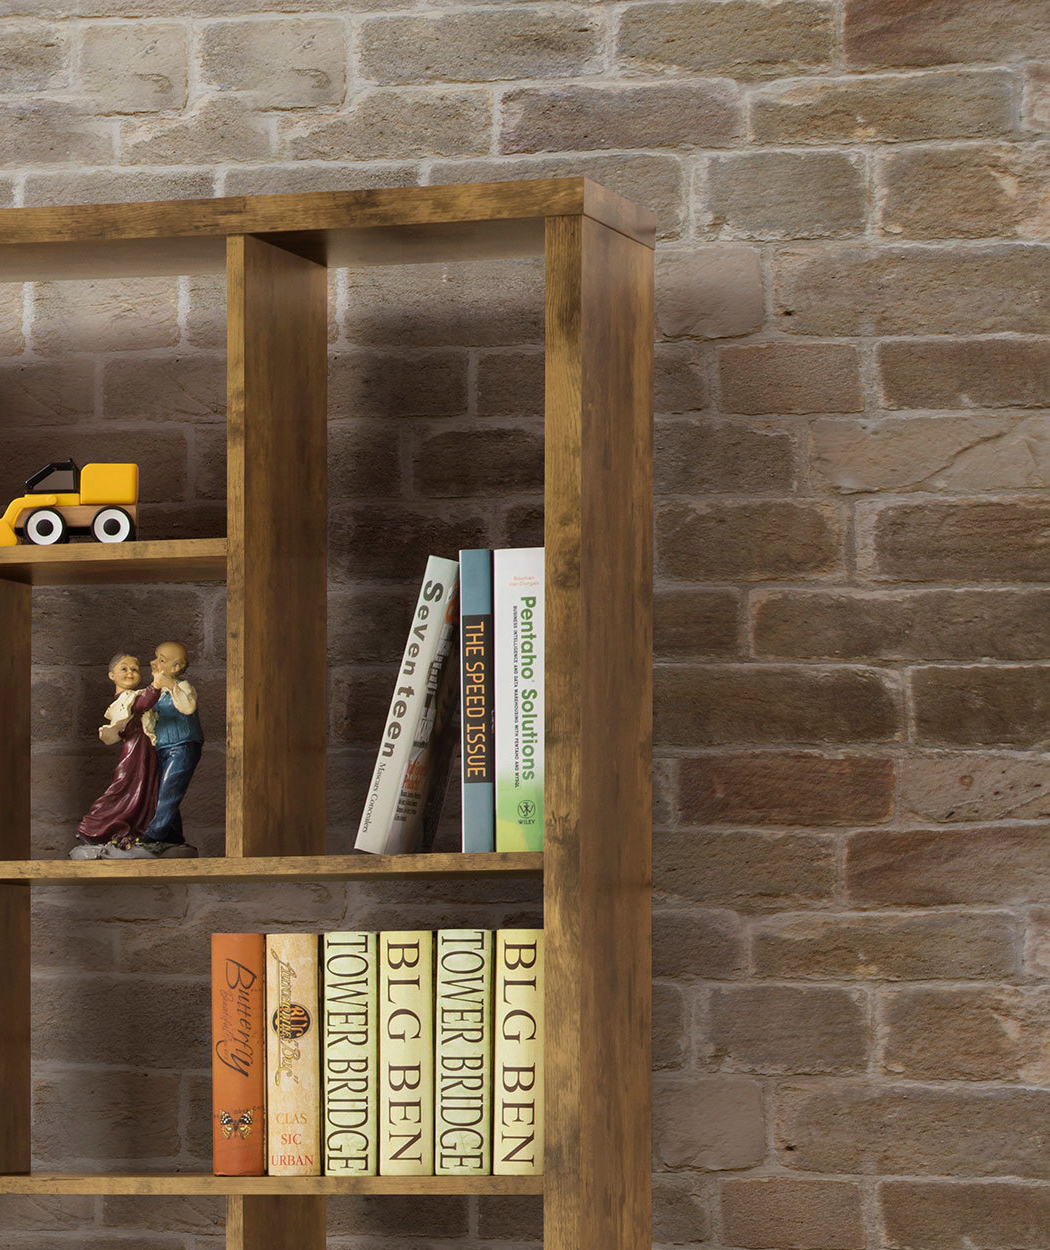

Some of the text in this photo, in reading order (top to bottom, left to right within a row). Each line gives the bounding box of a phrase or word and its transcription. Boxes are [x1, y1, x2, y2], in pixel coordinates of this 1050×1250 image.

[402, 580, 444, 676] Seven
[520, 596, 538, 780] Pentaho Solutions
[383, 685, 415, 757] teen
[466, 622, 486, 778] THE SPEED ISSUE
[362, 793, 379, 833] Concealers
[216, 957, 258, 1078] Butterfly
[326, 934, 370, 1172] TOWER BRIDGE
[386, 938, 423, 1165] BLG BEN
[439, 931, 486, 1170] TOWER BRIDGE
[501, 939, 537, 1167] BLG BEN
[271, 1155, 314, 1167] URBAN
[275, 1112, 308, 1124] CLAS
[280, 1134, 302, 1145] SIC
